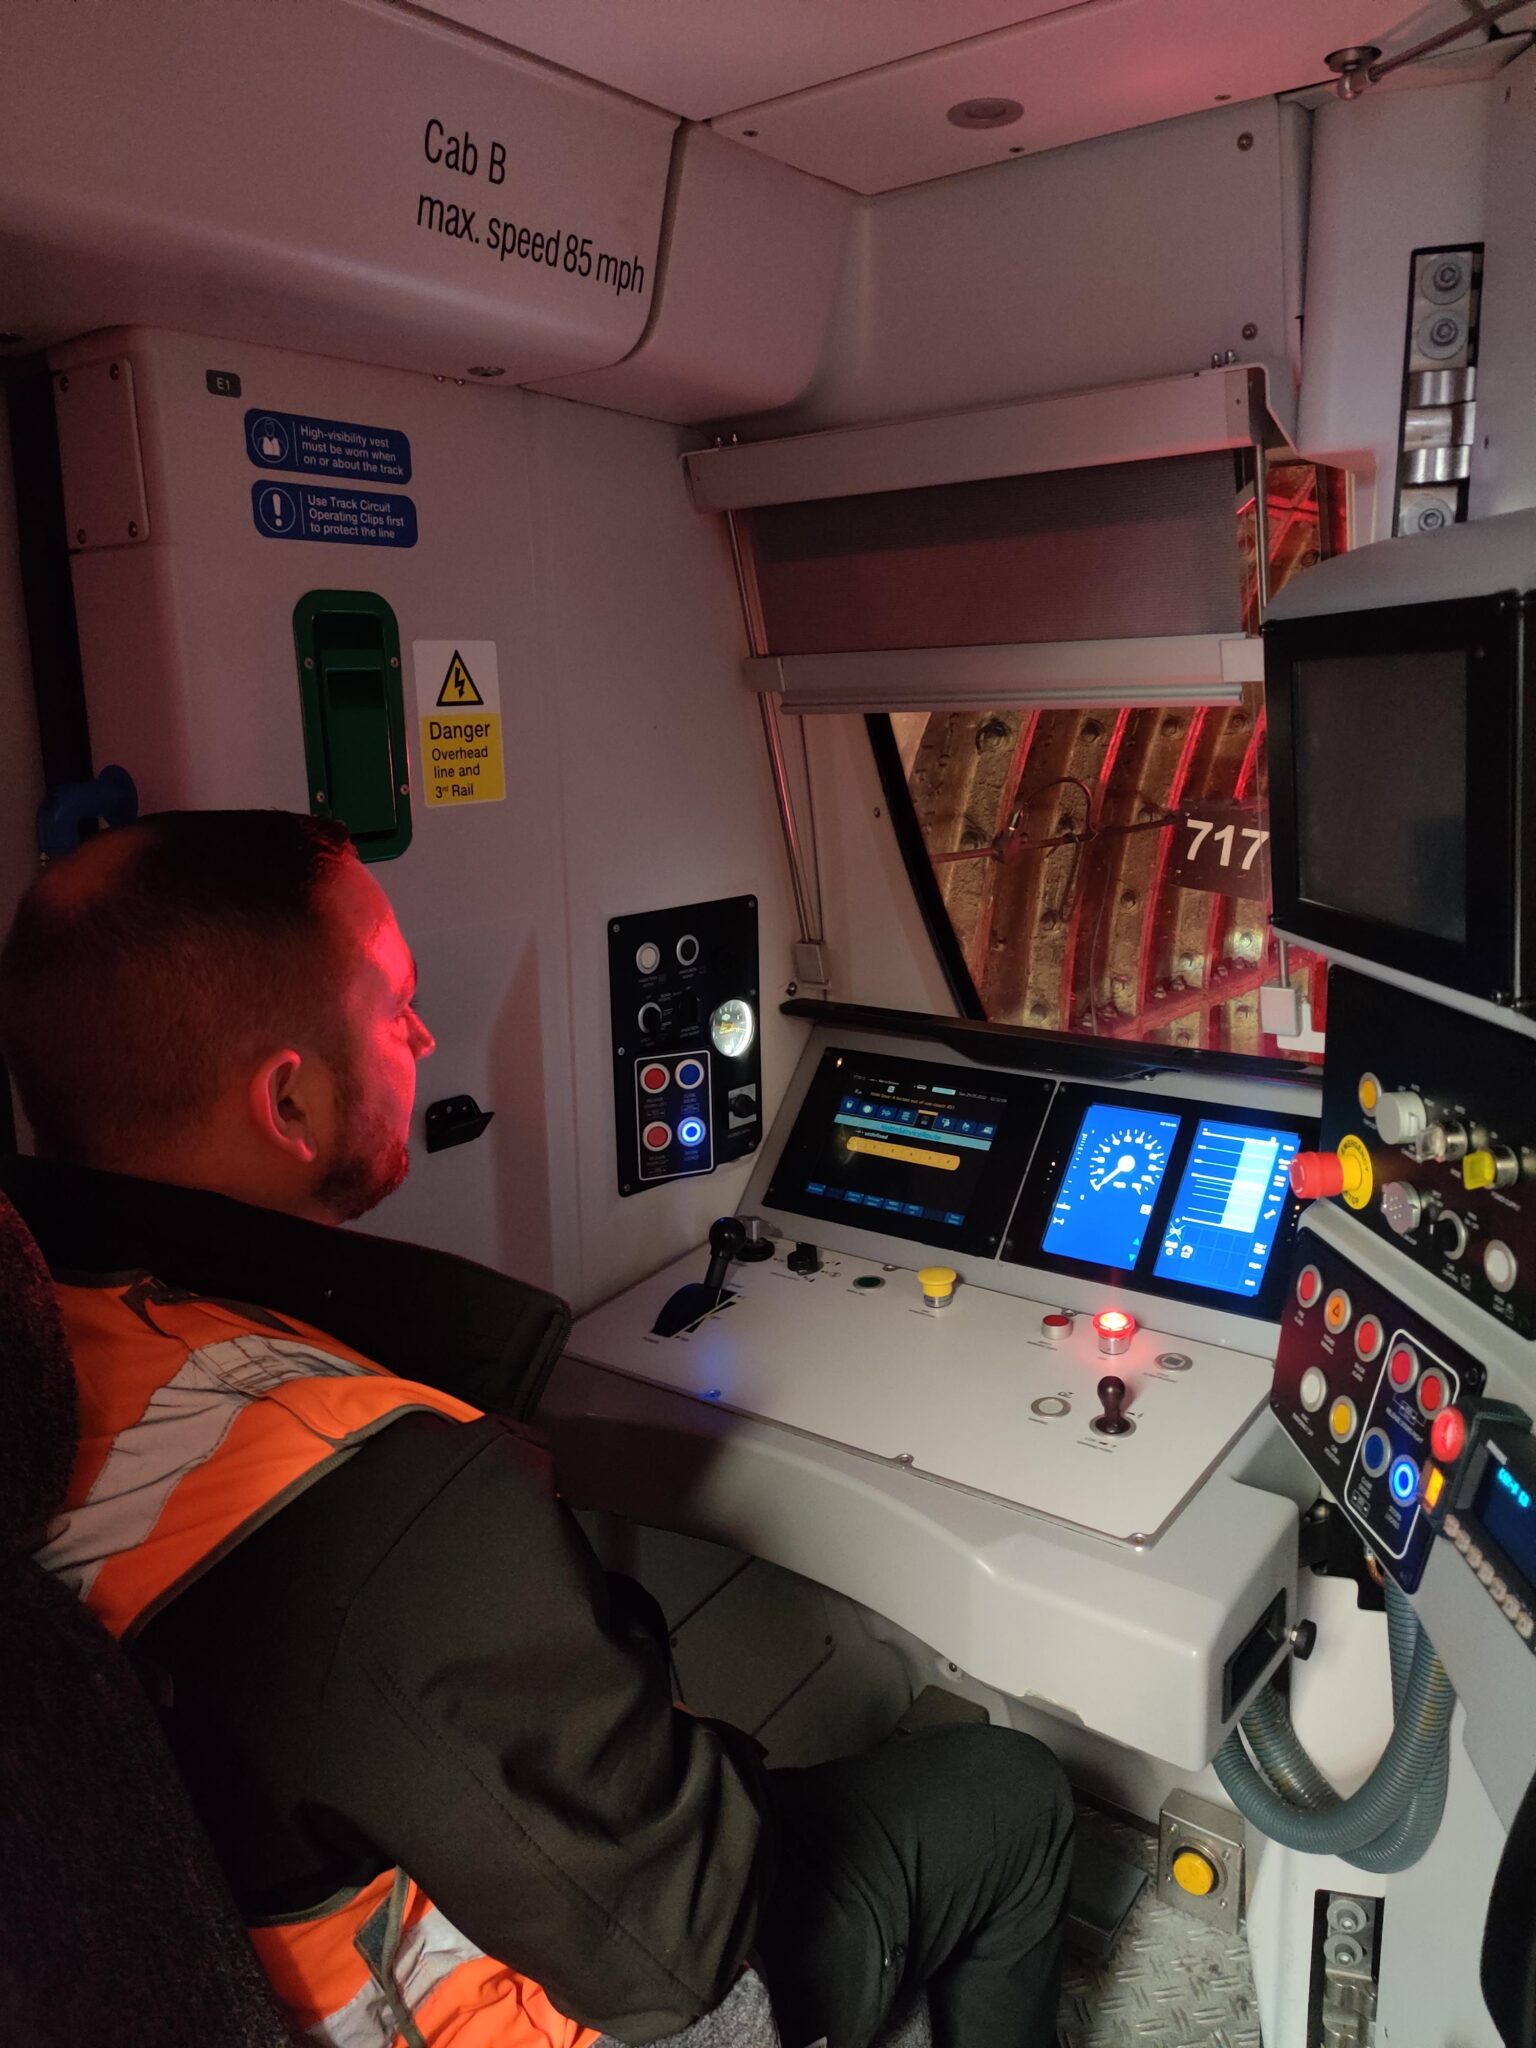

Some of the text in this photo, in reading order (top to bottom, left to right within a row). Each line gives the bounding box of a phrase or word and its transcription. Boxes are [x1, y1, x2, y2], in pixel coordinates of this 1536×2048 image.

[424, 118, 506, 185] Cab B
[416, 194, 645, 296] max. speed 85 mph
[216, 377, 231, 392] E1
[300, 424, 389, 449] High-visibility vest
[302, 441, 396, 462] must be worn when
[303, 455, 404, 476] on or about the track
[308, 495, 391, 513] Use Track Circuit
[309, 508, 405, 527] Operating Clips first
[310, 522, 395, 539] to protect the line
[429, 721, 491, 743] Danger
[431, 746, 488, 762] Overhead
[433, 763, 480, 779] line and
[451, 783, 474, 797] Rail
[1186, 818, 1270, 871] 717
